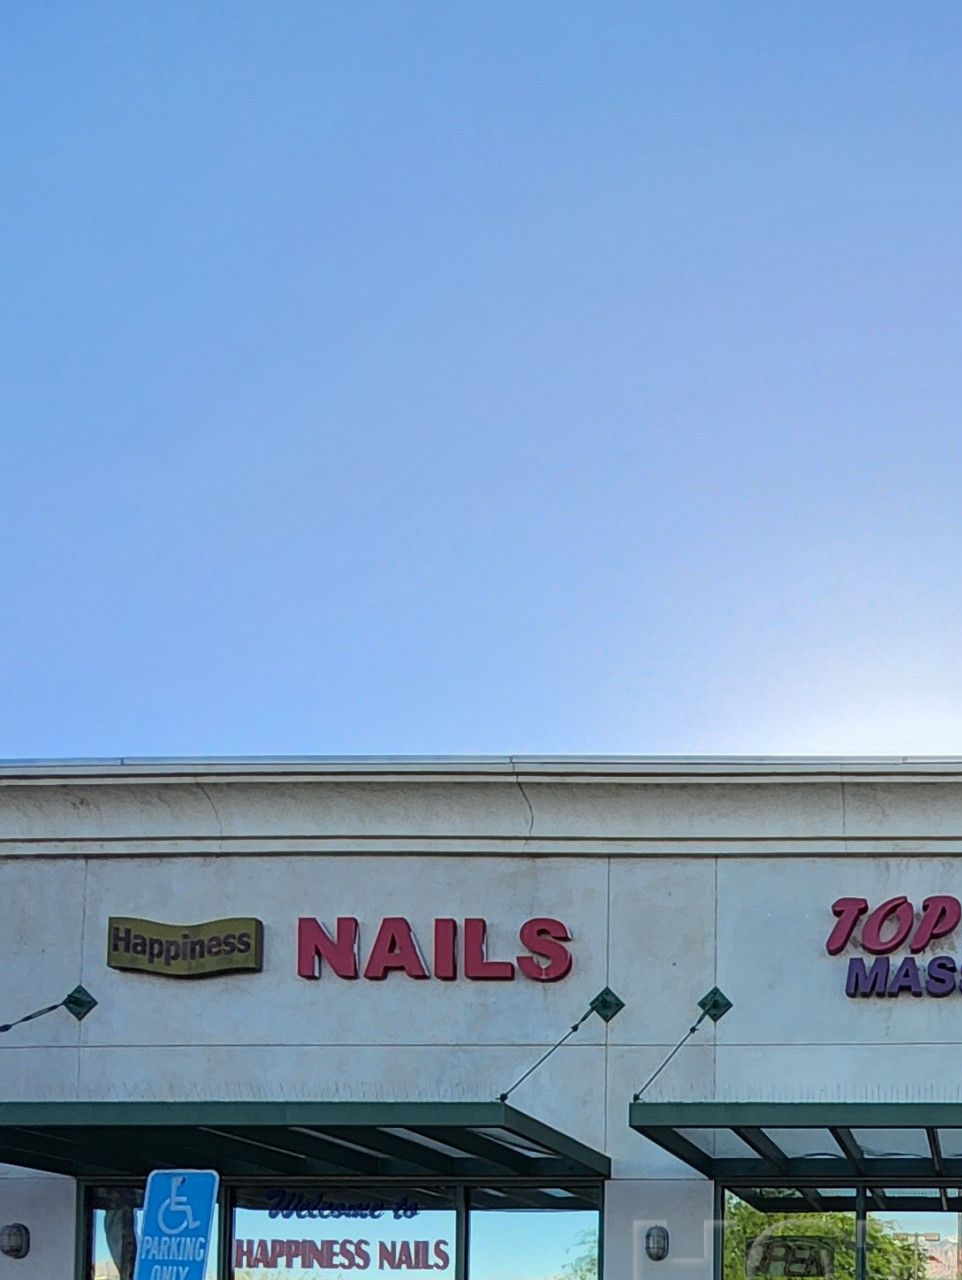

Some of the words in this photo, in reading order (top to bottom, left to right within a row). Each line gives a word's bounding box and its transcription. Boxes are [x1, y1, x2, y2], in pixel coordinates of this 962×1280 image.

[826, 895, 962, 955] TOP
[111, 926, 252, 967] Happiness
[297, 917, 573, 982] NAILS
[265, 1188, 385, 1220] Welcome
[392, 1196, 420, 1220] to
[141, 1236, 206, 1261] PARKING
[235, 1239, 370, 1270] HAPPINESS
[379, 1239, 450, 1270] NAILS
